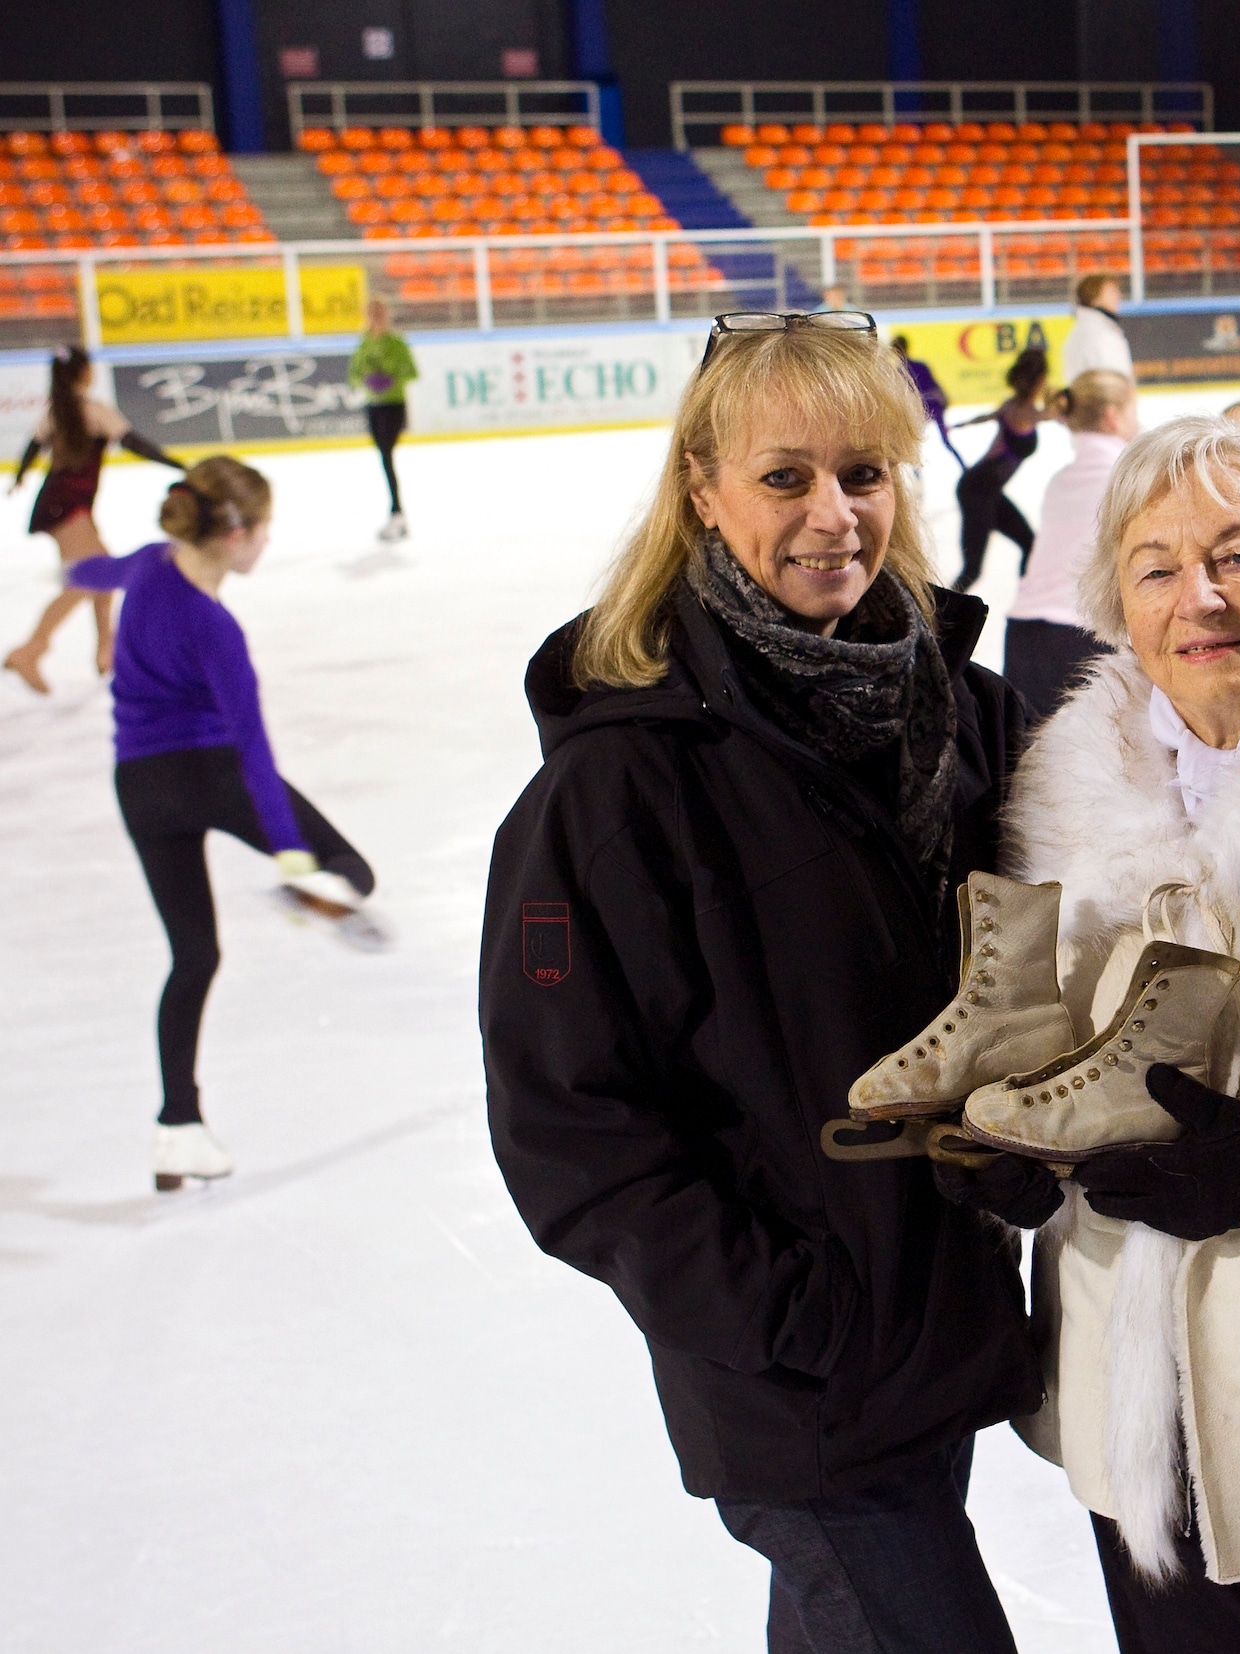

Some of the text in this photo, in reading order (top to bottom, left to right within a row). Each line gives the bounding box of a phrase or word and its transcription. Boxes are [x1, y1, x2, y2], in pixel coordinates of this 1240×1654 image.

[446, 361, 657, 408] DE ECHO
[535, 968, 560, 979] 1972
